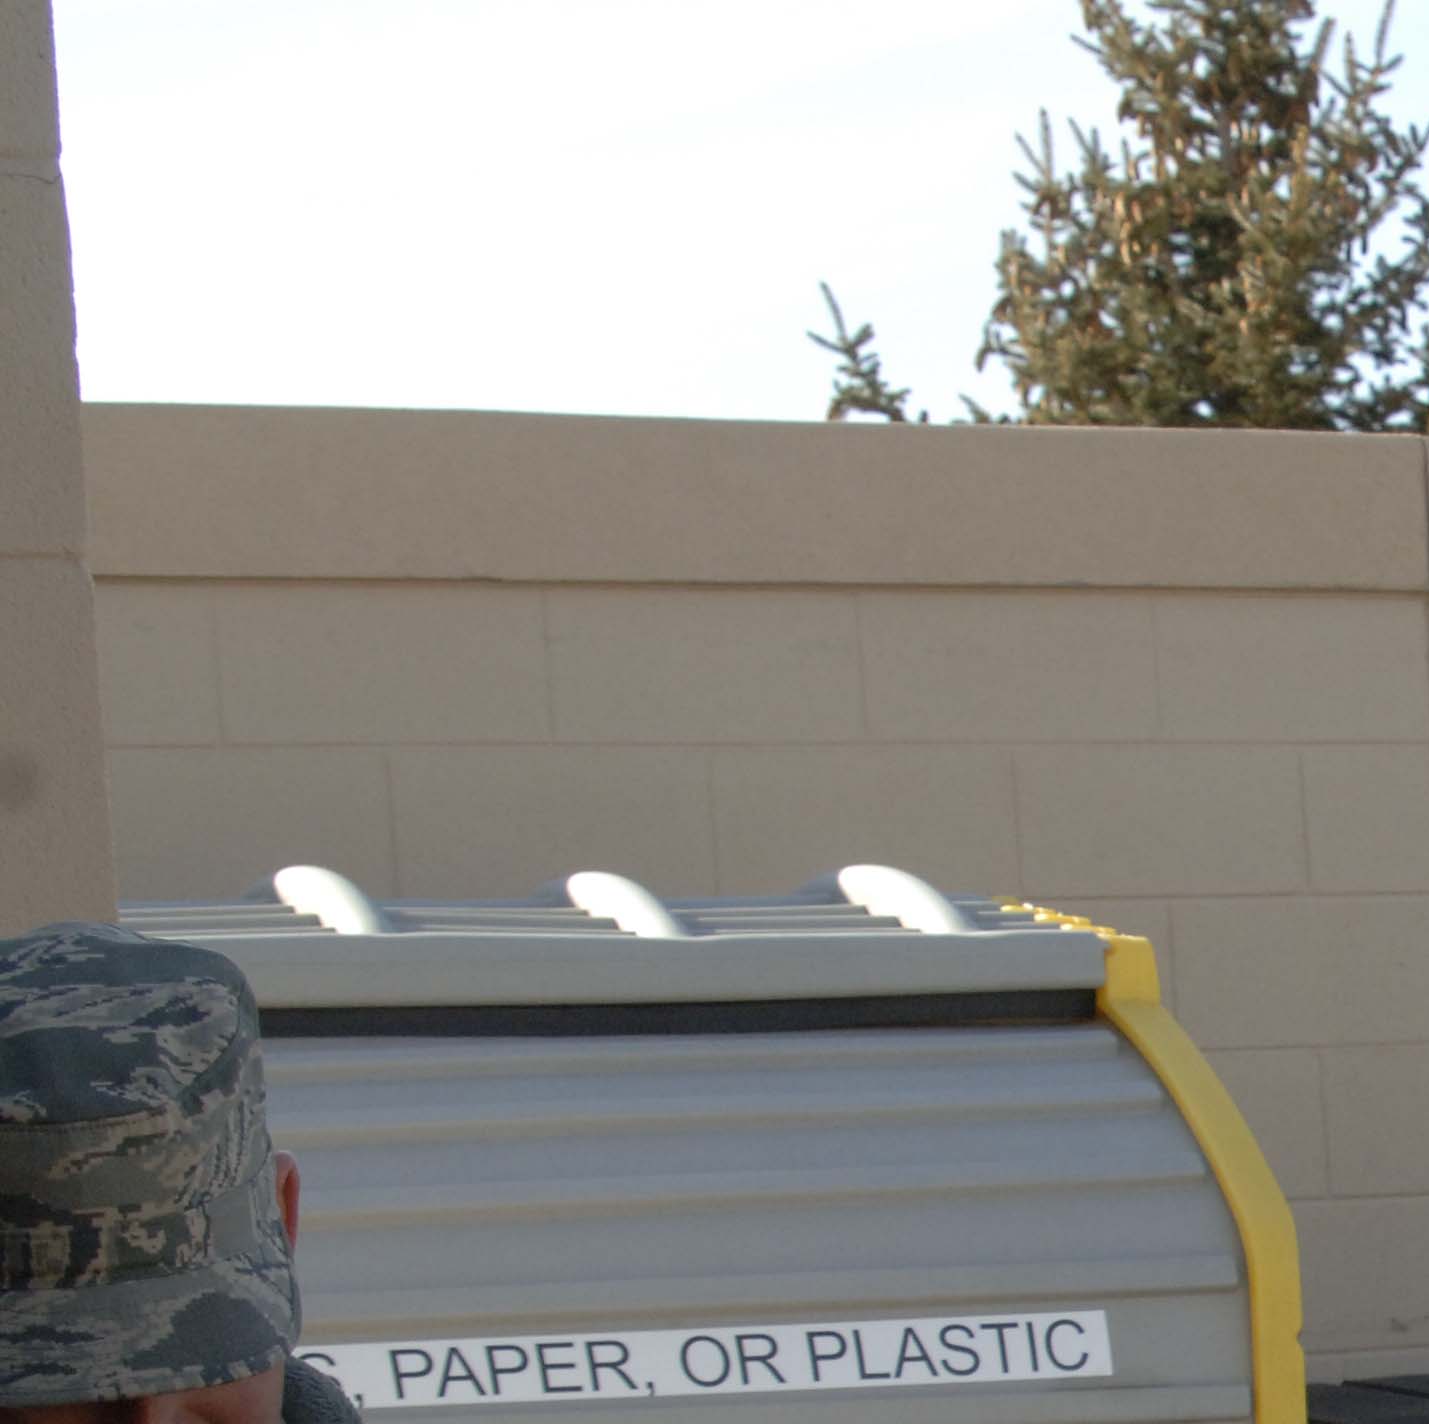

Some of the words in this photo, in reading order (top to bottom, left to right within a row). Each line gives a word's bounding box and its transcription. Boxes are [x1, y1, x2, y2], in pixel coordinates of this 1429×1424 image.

[389, 1340, 655, 1399] PAPER,
[680, 1333, 788, 1387] OR
[806, 1319, 1089, 1382] PLASTIC
